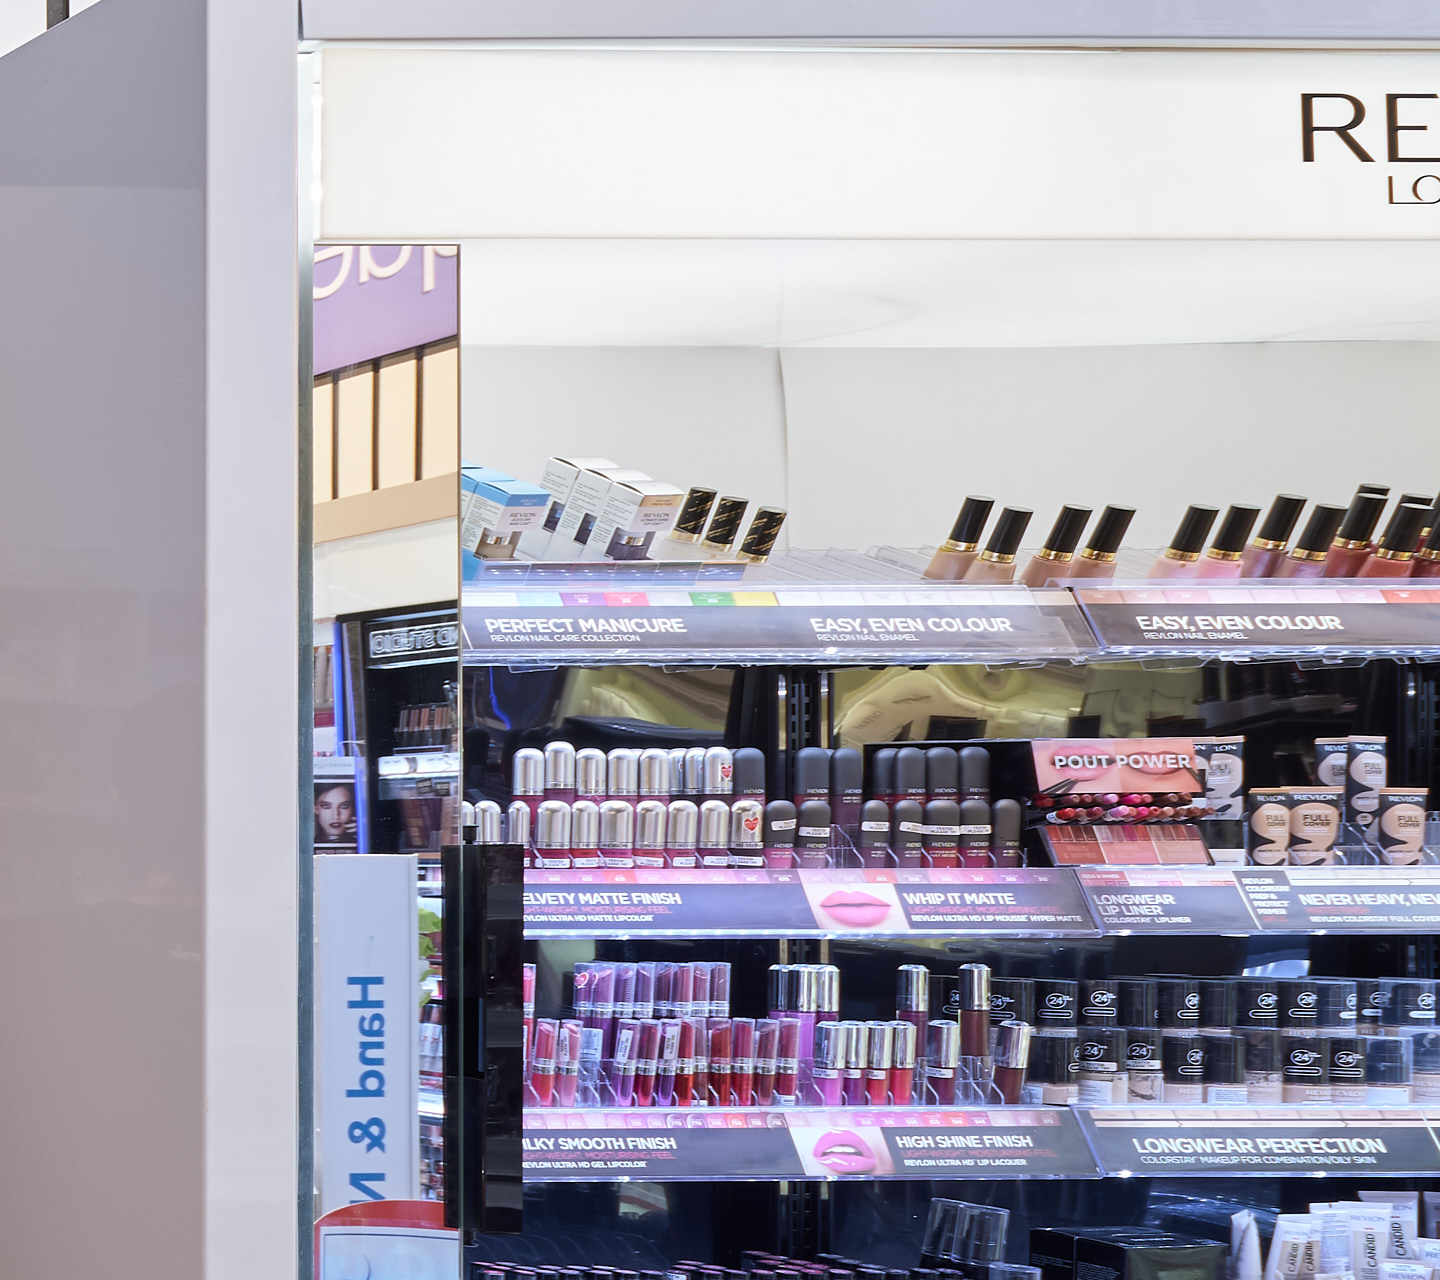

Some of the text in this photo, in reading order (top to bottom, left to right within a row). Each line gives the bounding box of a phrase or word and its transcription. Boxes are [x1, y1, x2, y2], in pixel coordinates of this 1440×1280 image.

[484, 618, 687, 633] PERFECT MANICURE
[812, 618, 1013, 632] EASY, EVEN COLOUR
[490, 634, 640, 642] REVLON NAIL CARE COLLECTION
[1055, 755, 1191, 769] POUT POWER
[903, 893, 1016, 905] WHIP IT MATTE
[895, 1135, 1033, 1148] HIGH SHINE FINISH
[1132, 1138, 1387, 1154] LONGWEAR PERFECTION
